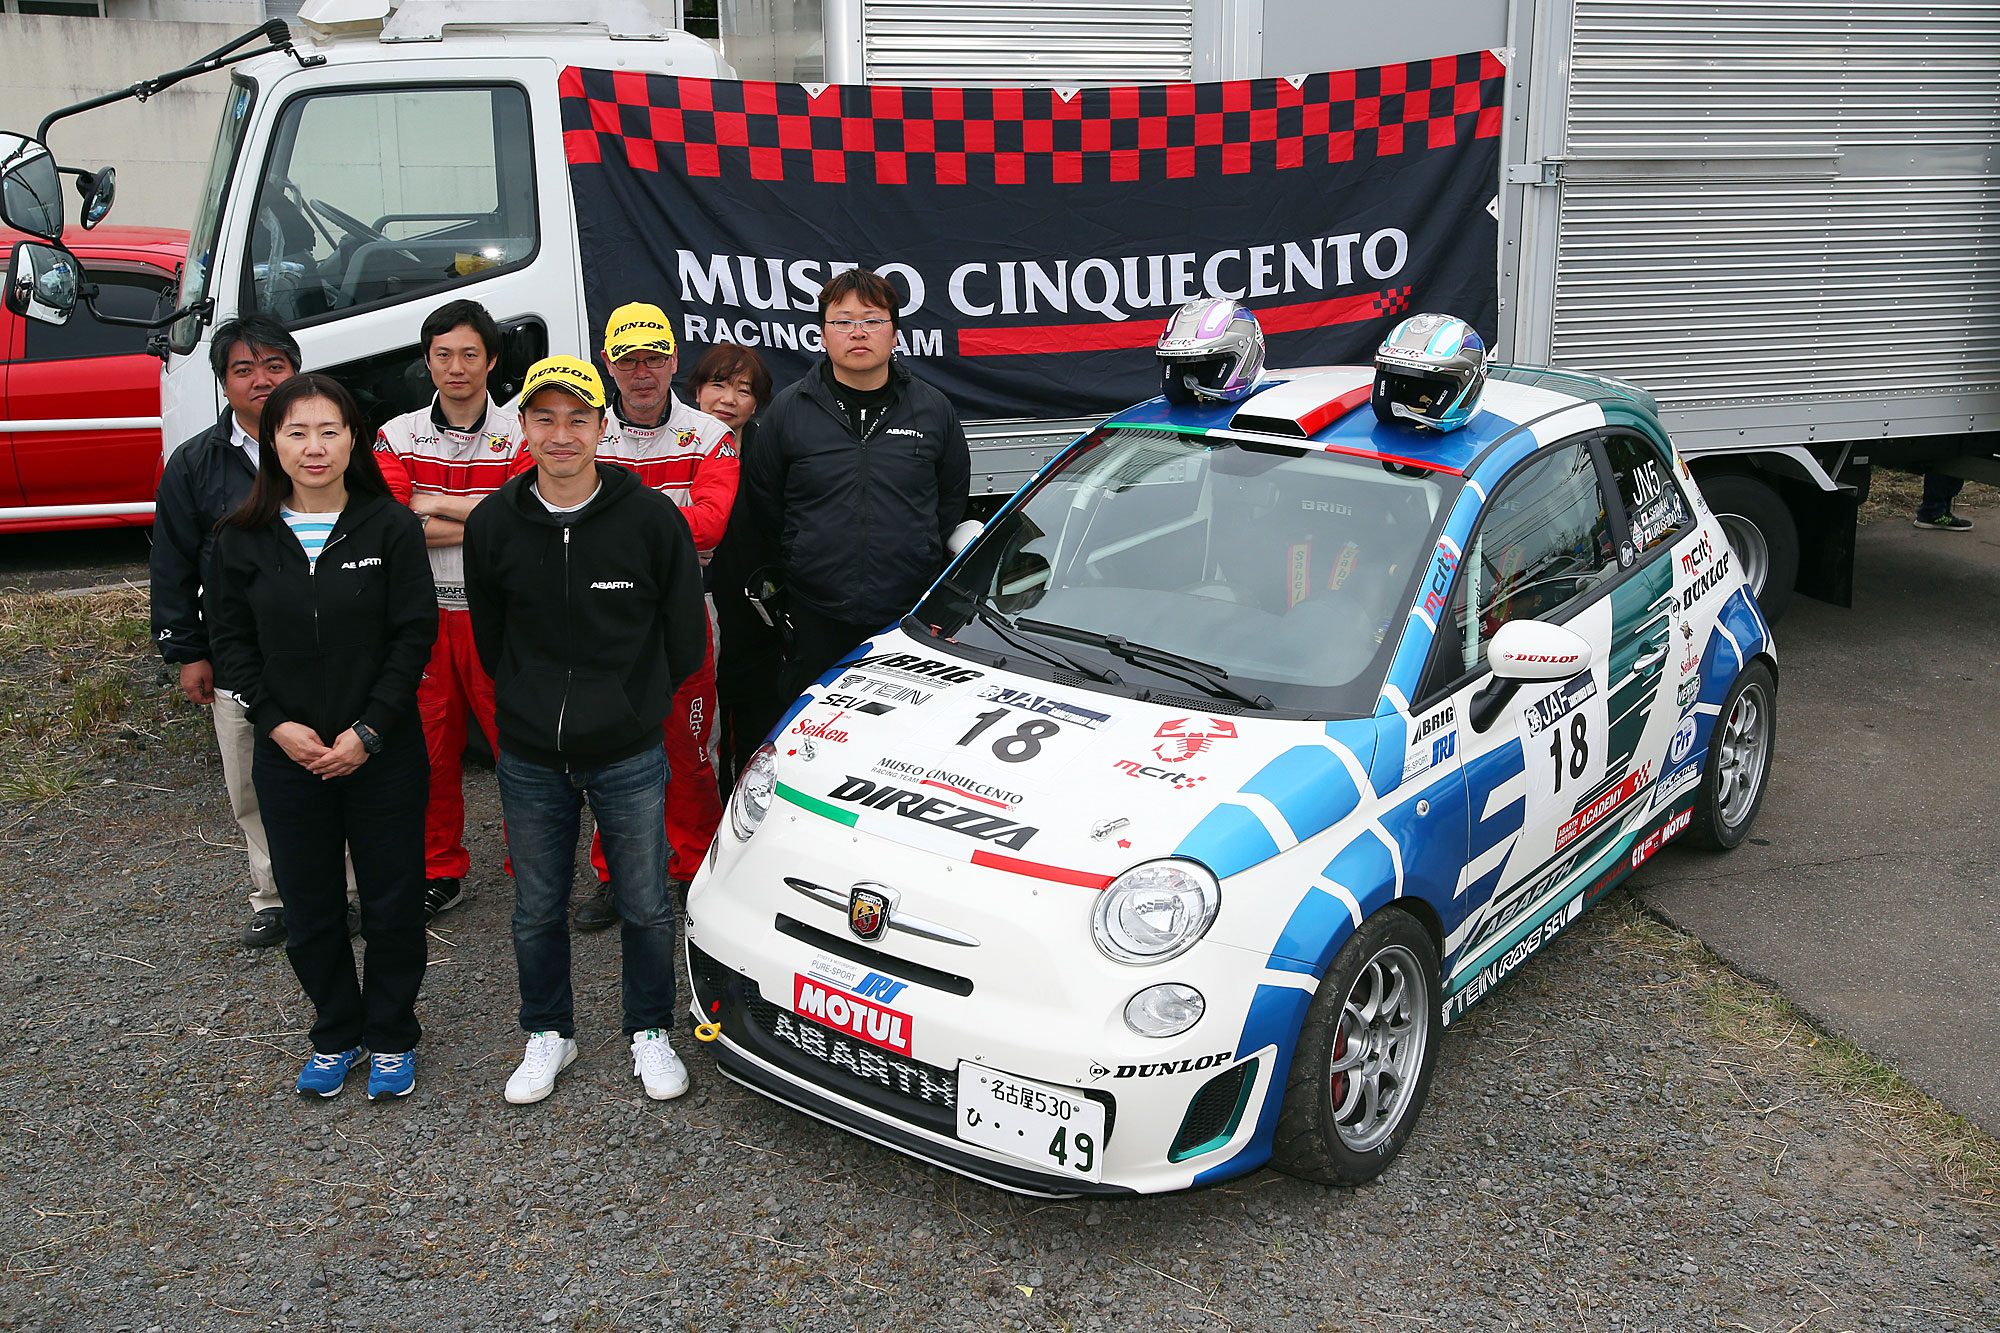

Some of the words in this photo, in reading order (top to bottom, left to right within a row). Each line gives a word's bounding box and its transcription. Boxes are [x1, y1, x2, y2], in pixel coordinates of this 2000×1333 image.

[676, 248, 926, 318] MUSO
[947, 227, 1409, 322] CINQUECENTO
[613, 321, 665, 338] DUNLOP
[683, 312, 825, 353] RACING
[892, 328, 944, 358] AM
[527, 366, 594, 385] DUNLOP
[886, 428, 924, 439] ABARTH
[1632, 459, 1661, 506] JN5
[590, 581, 634, 590] ABARTH
[1683, 550, 1730, 611] DUNLOP
[877, 654, 986, 684] BRIG
[1514, 653, 1579, 664] DUNLOP
[818, 693, 868, 709] SEV
[860, 678, 934, 706] TEIN
[1542, 685, 1568, 726] JAF
[791, 710, 849, 744] Seiken
[956, 707, 1060, 763] 18
[1422, 706, 1454, 737] BRIG
[1550, 712, 1589, 794] 18
[870, 767, 898, 778] RACING
[898, 773, 920, 784] TEAM
[876, 757, 925, 776] MUSEO
[925, 769, 1024, 804] CINQUECENTO
[1112, 759, 1189, 785] mcrt
[827, 775, 1041, 852] DIREZZA
[1579, 786, 1624, 831] ACADEMY
[1557, 817, 1579, 839] ABARTH
[1661, 809, 1692, 844] MOTUL
[1476, 854, 1579, 945] ABARTH
[1499, 925, 1543, 979] RAYS
[1544, 904, 1569, 941] SEV
[811, 959, 857, 982] PURE-SPORT
[798, 982, 907, 1049] MOTUL
[773, 1013, 957, 1108] ABARTH
[1113, 1051, 1233, 1079] DUNLOP
[966, 1106, 983, 1127] ひ
